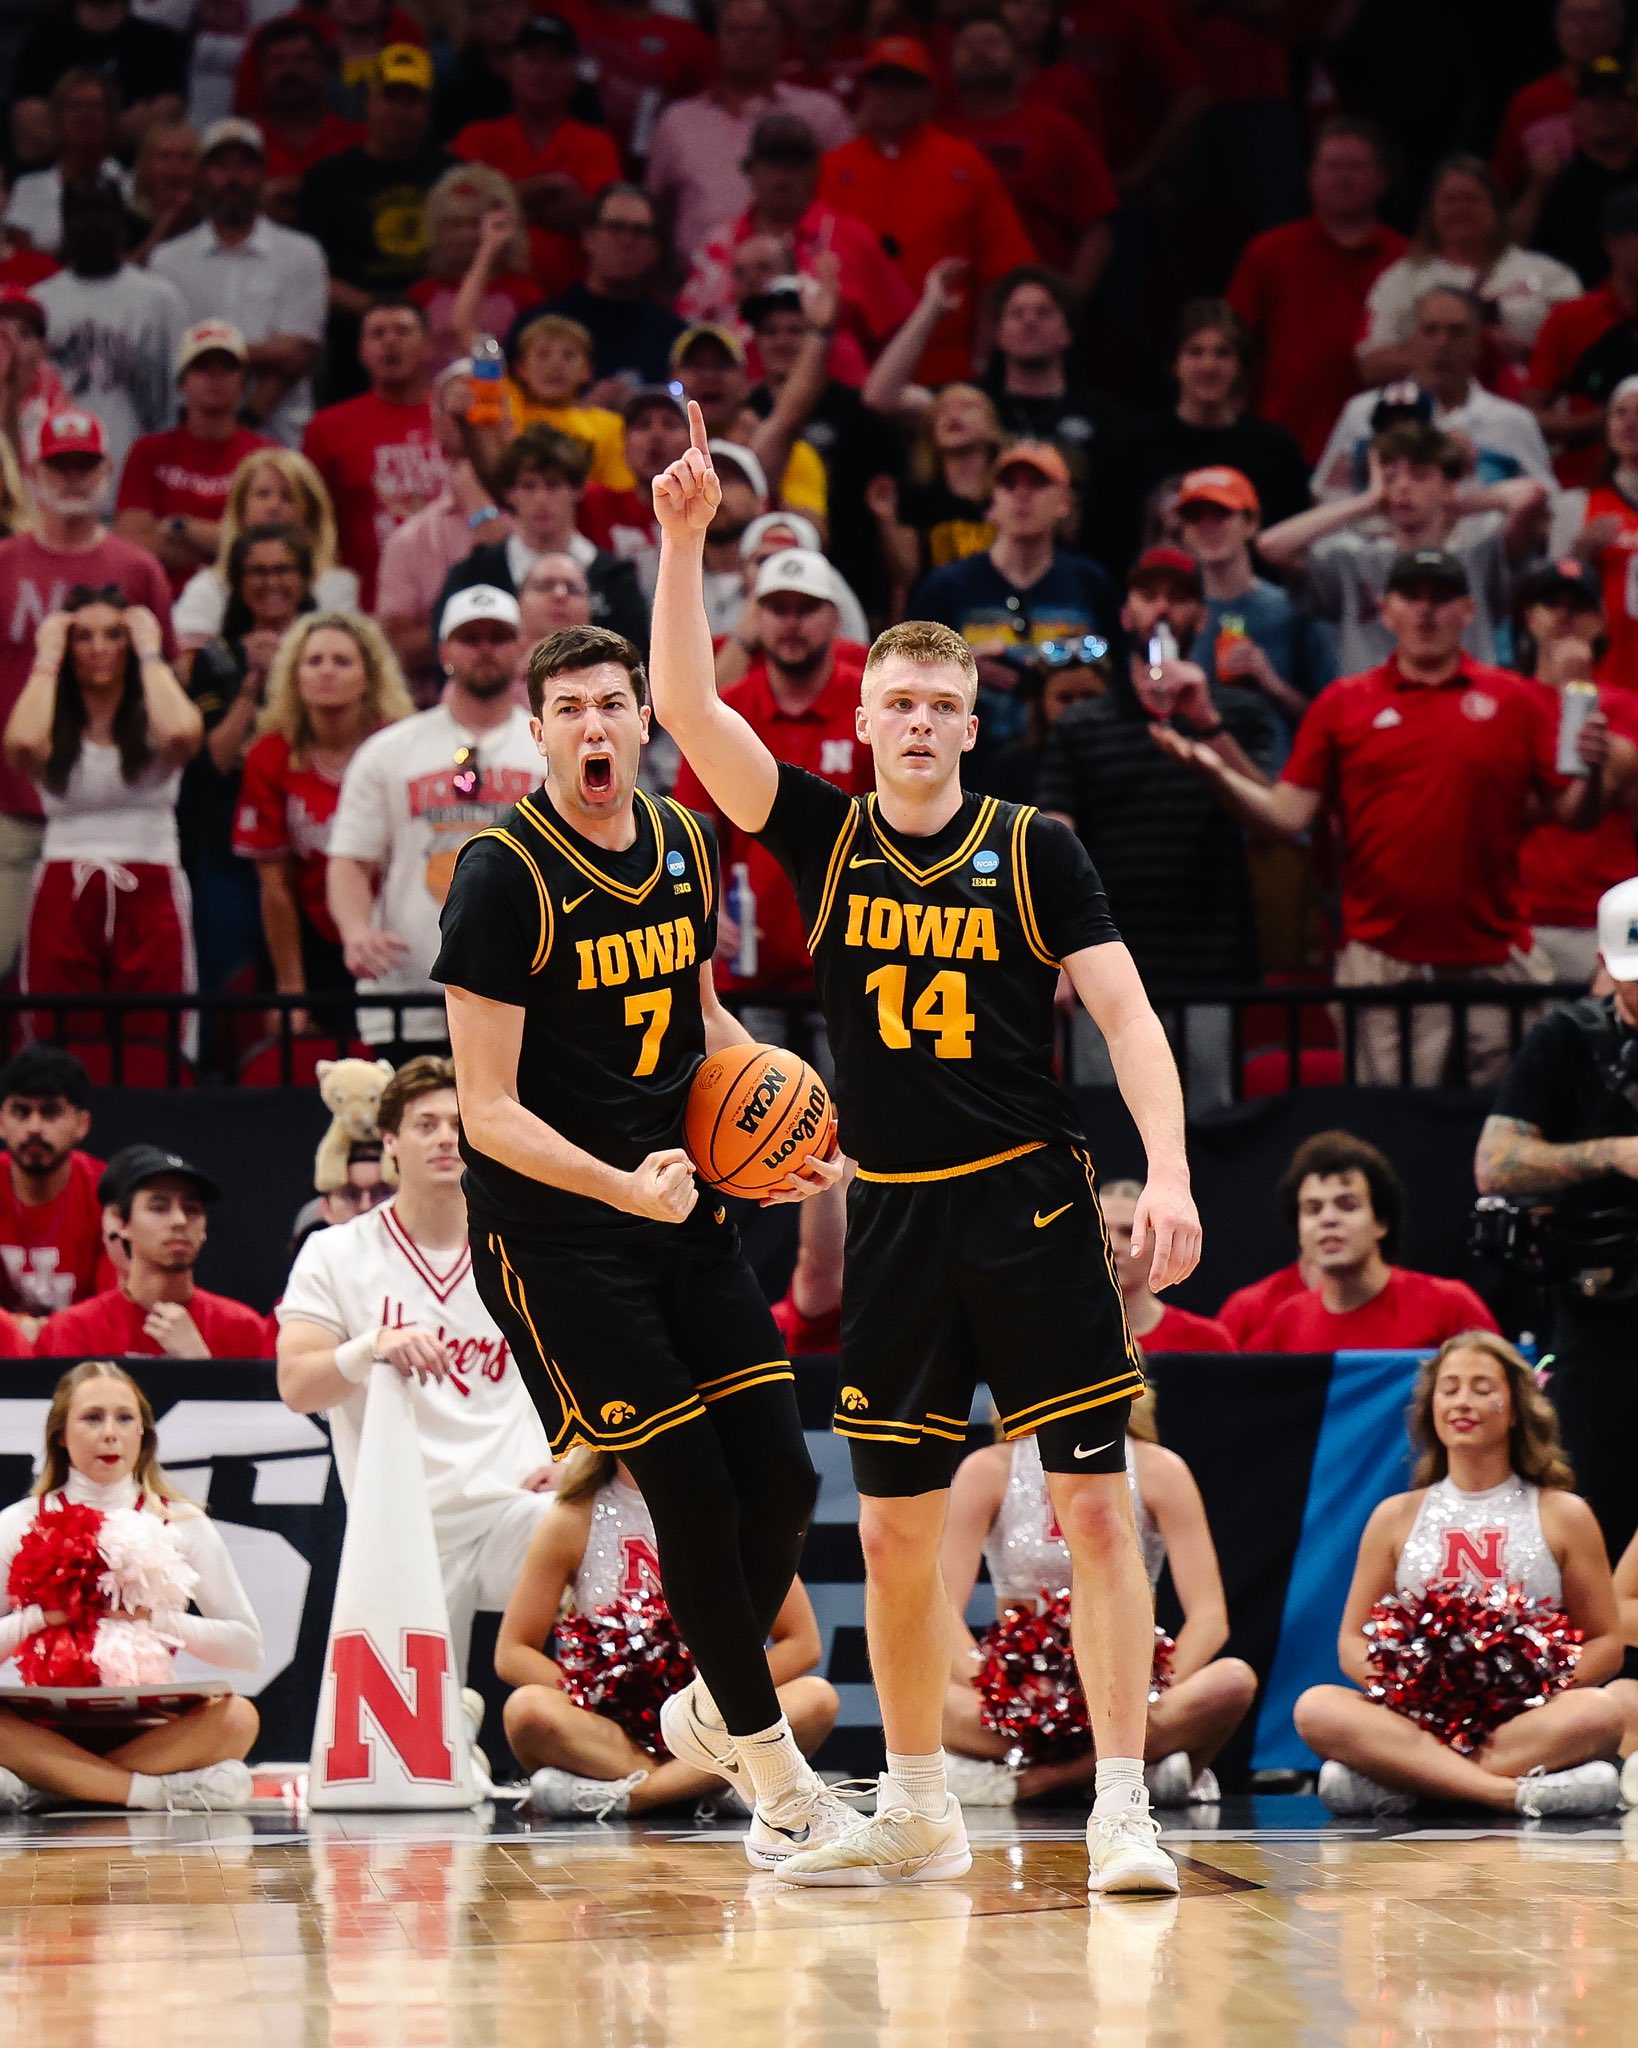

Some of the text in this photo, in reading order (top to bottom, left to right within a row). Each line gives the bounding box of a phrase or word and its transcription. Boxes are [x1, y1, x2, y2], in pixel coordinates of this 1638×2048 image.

[976, 860, 998, 868] NCAA
[575, 916, 696, 990] IOWA
[845, 894, 1000, 962] IOWA
[623, 987, 673, 1077] 7
[864, 964, 976, 1060] 14
[735, 1065, 788, 1135] NCAA
[762, 1084, 826, 1170] Wilson
[1438, 1526, 1508, 1581] N
[323, 1628, 457, 1788] N
